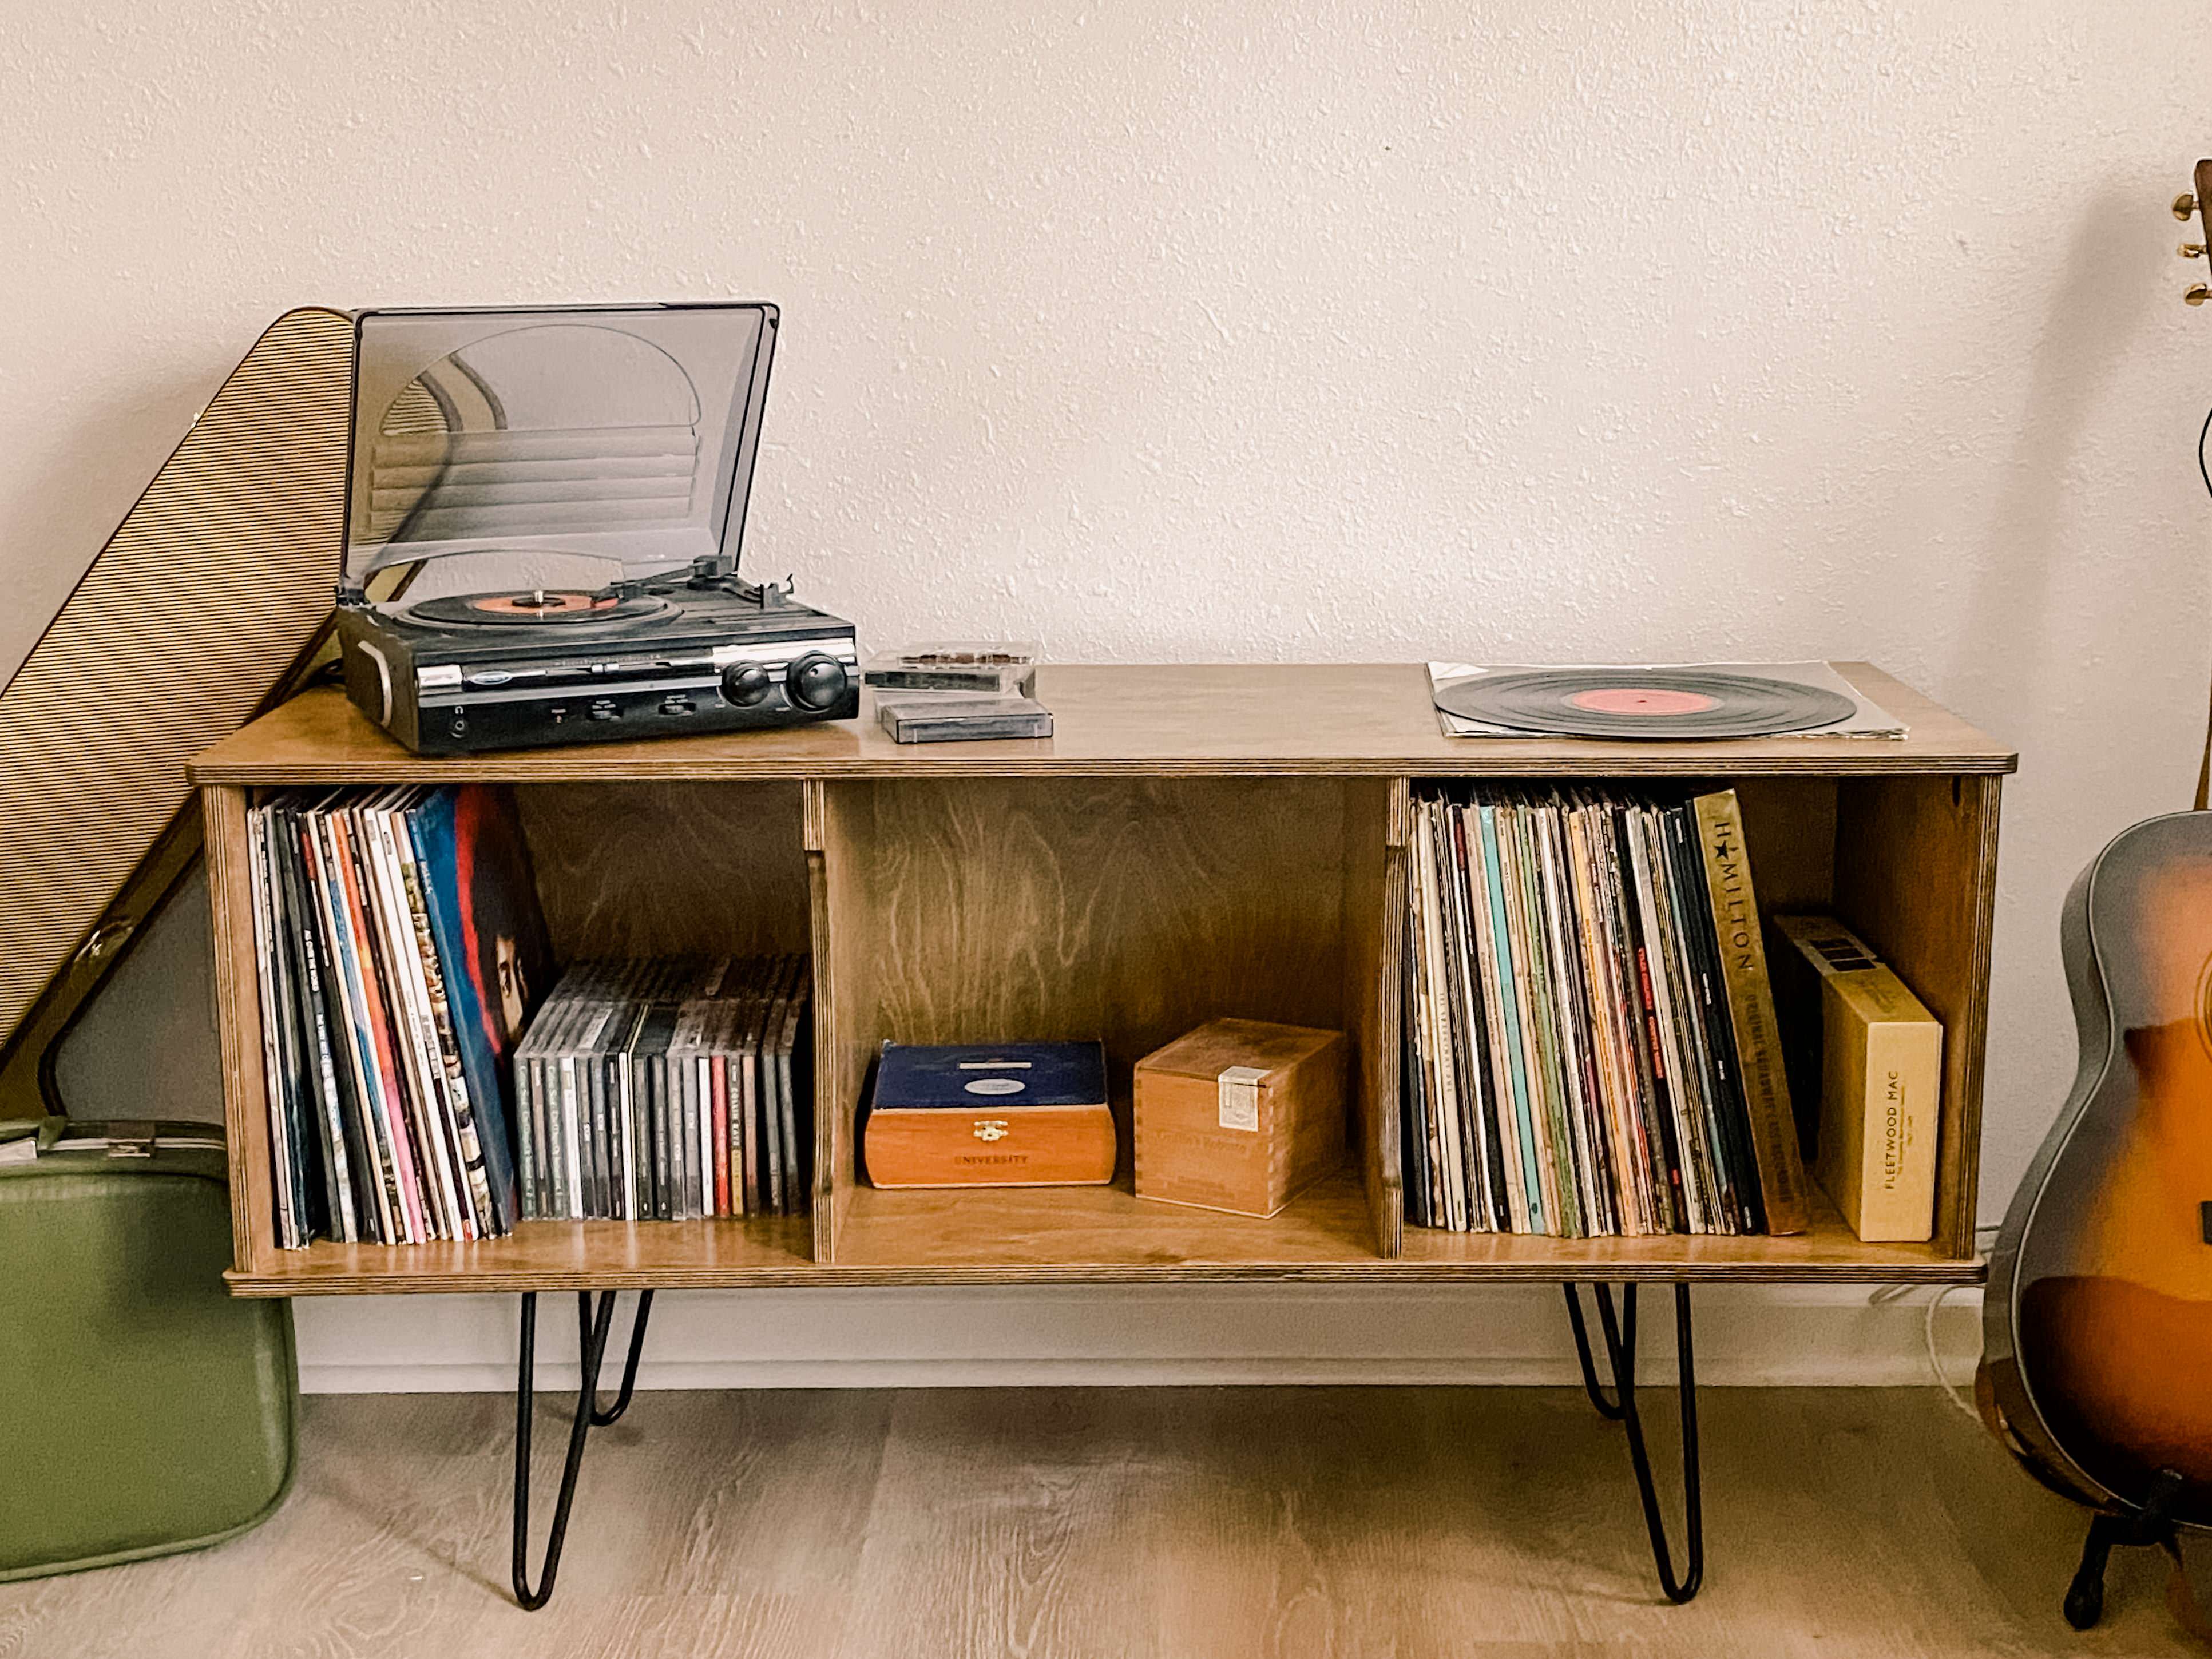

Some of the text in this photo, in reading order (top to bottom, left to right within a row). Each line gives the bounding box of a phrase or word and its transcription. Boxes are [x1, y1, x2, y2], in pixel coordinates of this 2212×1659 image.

[954, 1155, 1028, 1164] UNIVERSITY
[1885, 1071, 1898, 1189] FLEETWOOD MAC
